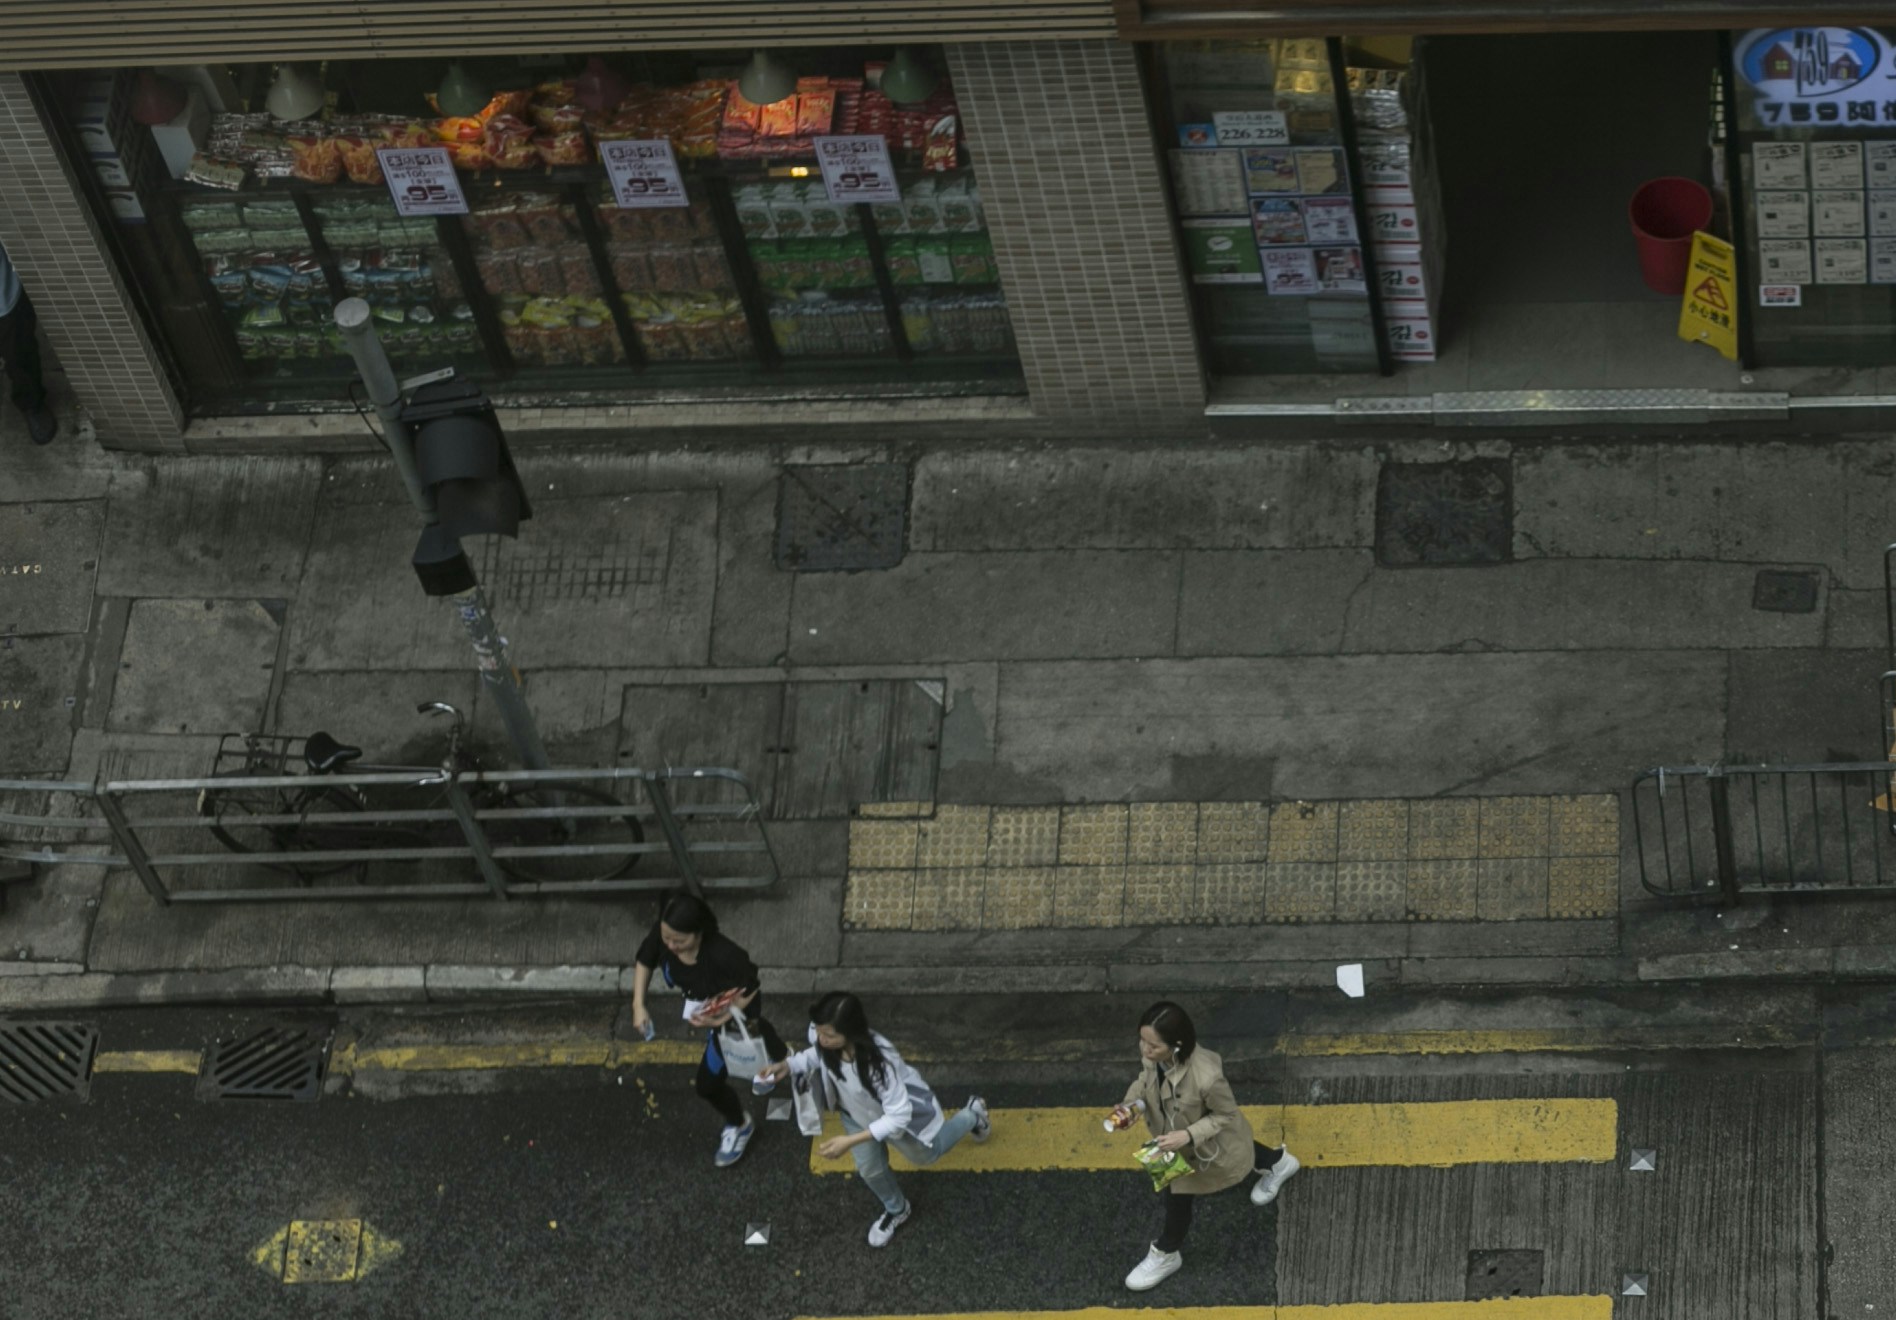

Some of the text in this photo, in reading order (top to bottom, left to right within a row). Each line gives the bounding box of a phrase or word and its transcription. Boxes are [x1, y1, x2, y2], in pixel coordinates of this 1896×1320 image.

[1792, 29, 1828, 98] 759
[1220, 127, 1286, 140] 226 228
